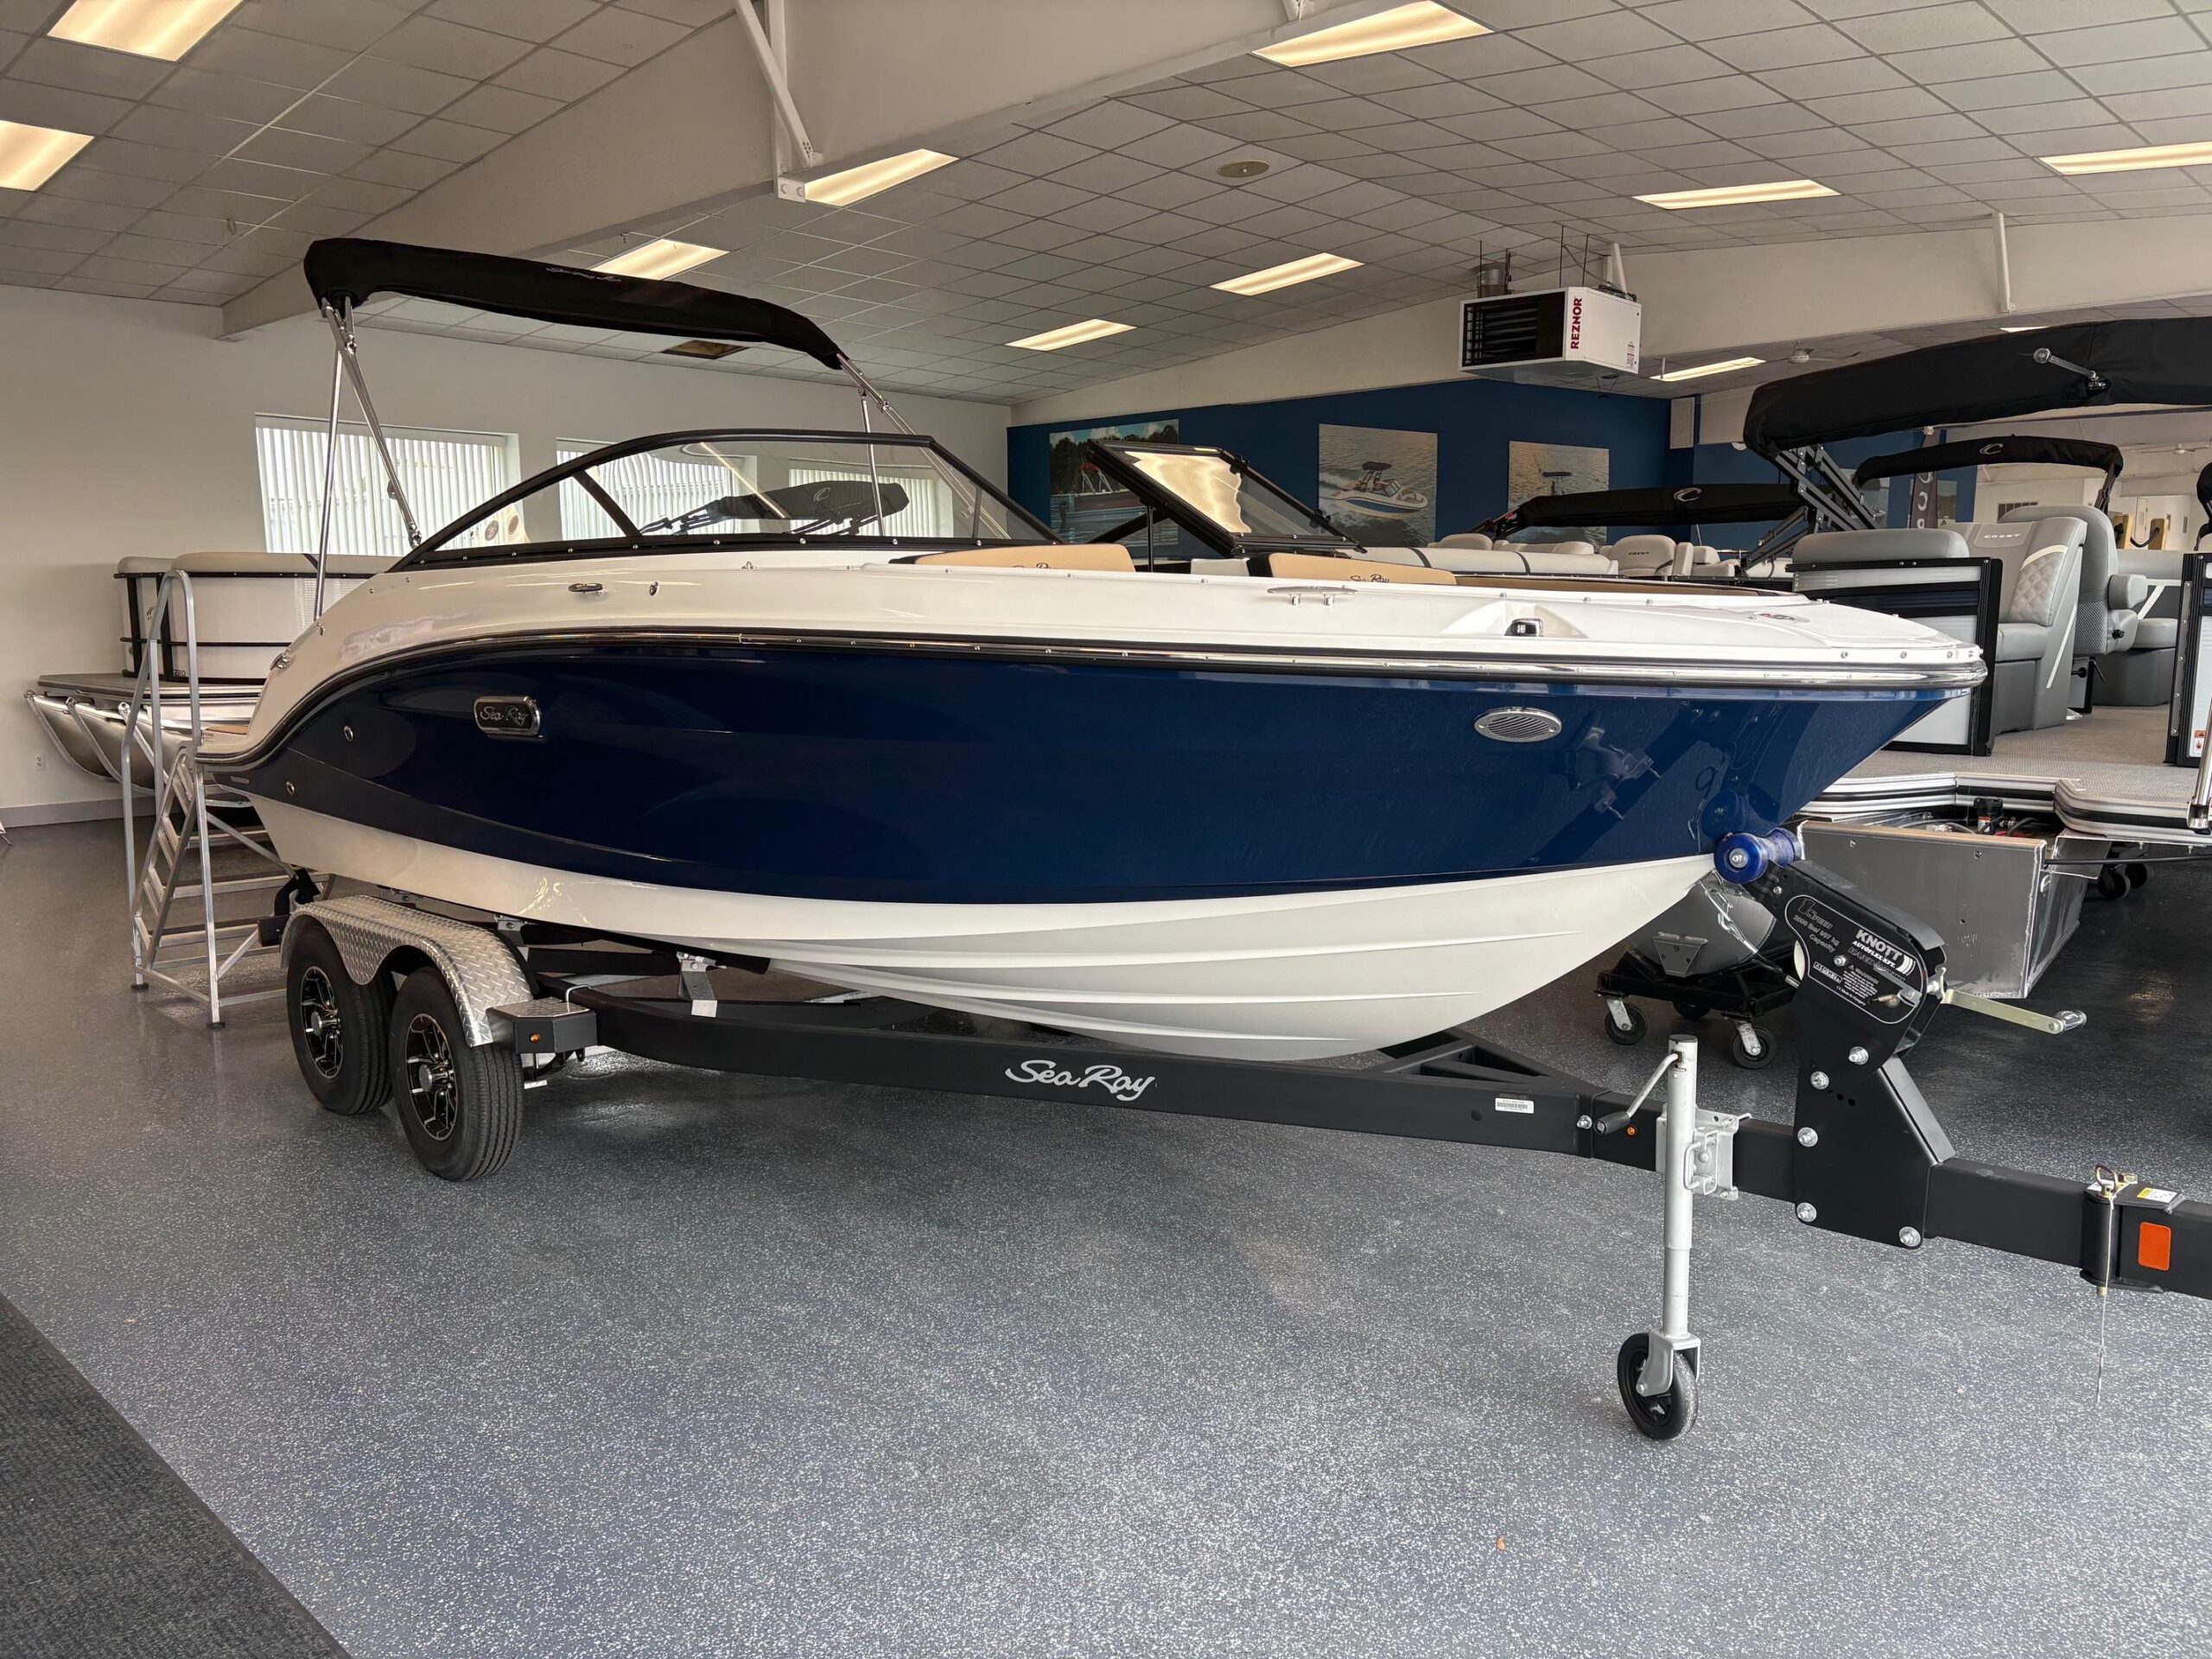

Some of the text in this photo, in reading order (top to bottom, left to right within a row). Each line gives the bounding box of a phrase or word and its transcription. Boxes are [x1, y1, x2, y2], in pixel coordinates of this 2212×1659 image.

[1571, 298, 1582, 349] REZNOR
[480, 705, 529, 726] Sea Ray
[1809, 933, 1836, 953] Capacity
[1856, 929, 1903, 962] KNOTT
[1005, 1059, 1155, 1102] Sea Ray
